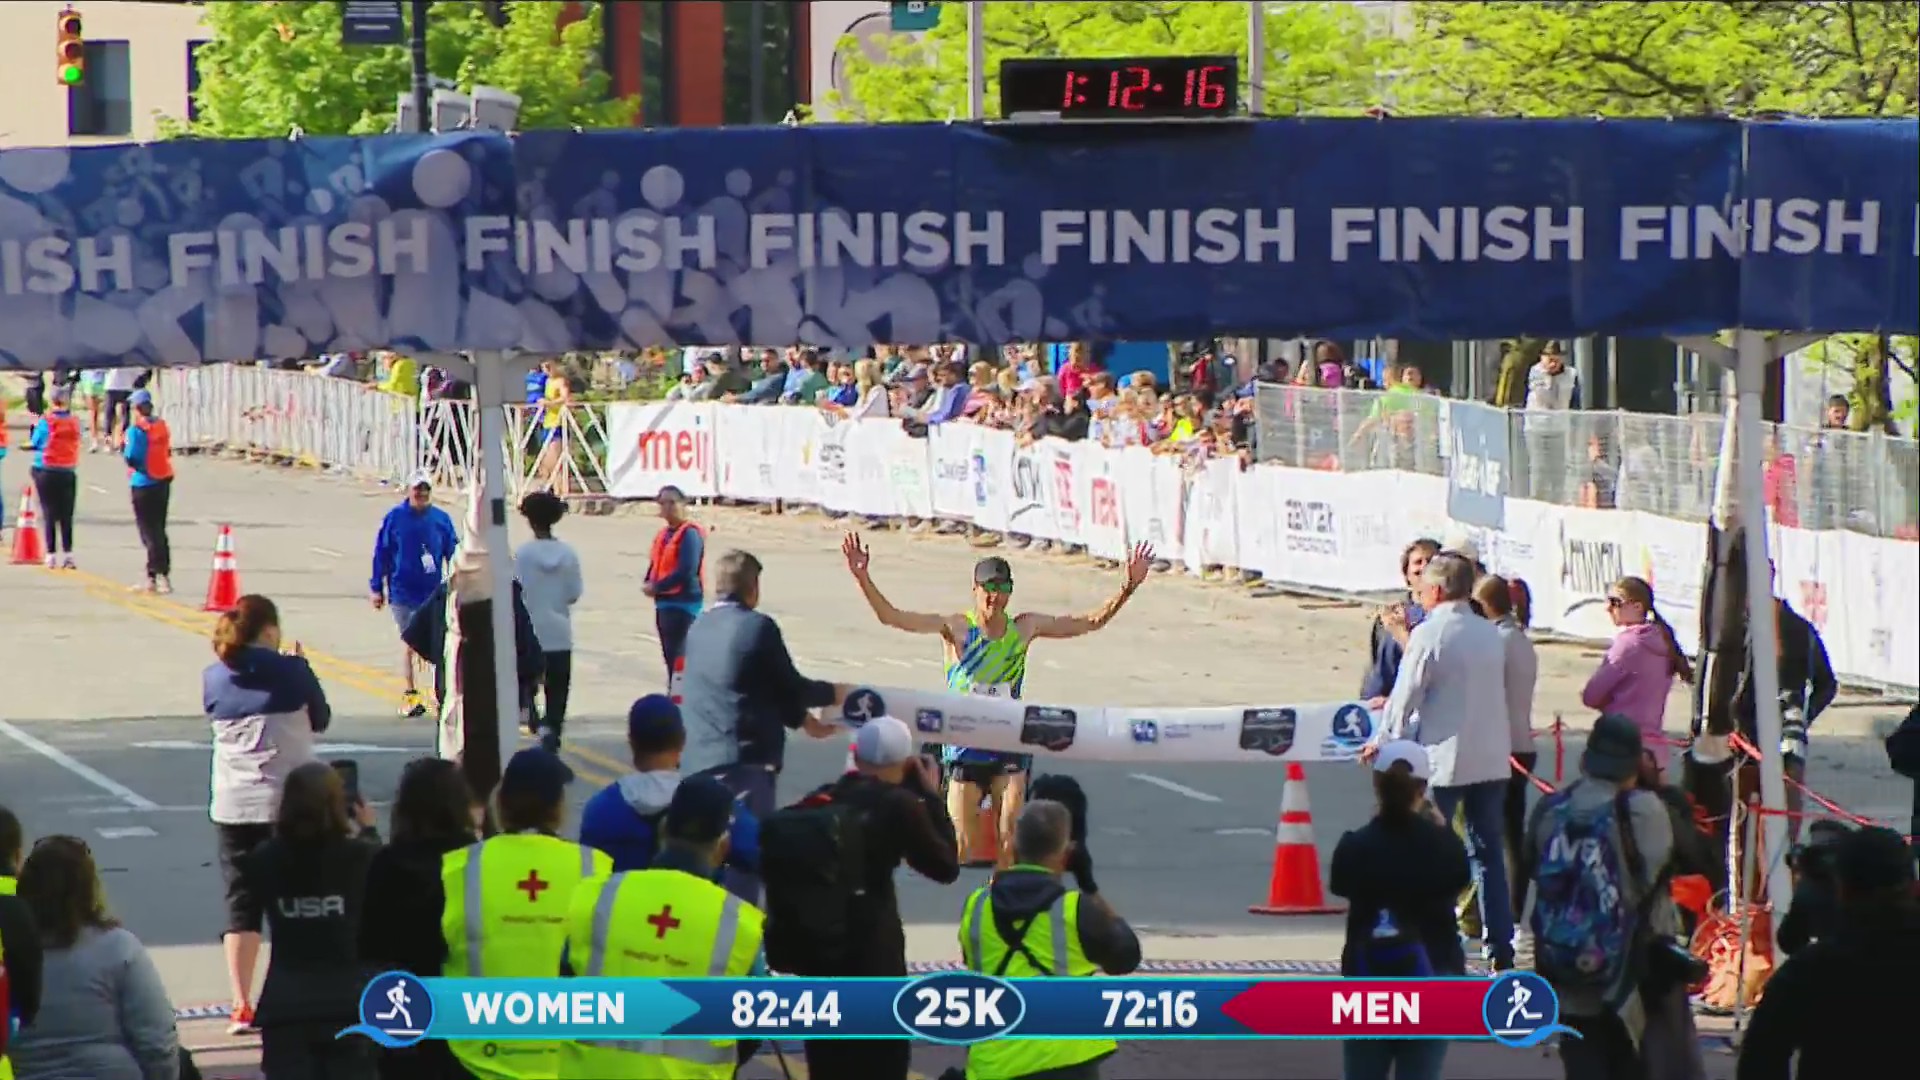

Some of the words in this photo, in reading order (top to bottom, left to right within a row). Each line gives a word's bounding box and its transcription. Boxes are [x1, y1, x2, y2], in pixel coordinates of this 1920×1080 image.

[169, 217, 429, 288] FINISH
[466, 215, 716, 275] FINISH
[750, 209, 1005, 269] FINISH
[1041, 207, 1296, 264] FINISH
[1331, 206, 1584, 262] FINISH
[1620, 198, 1880, 260] FINISH
[278, 895, 345, 918] USA
